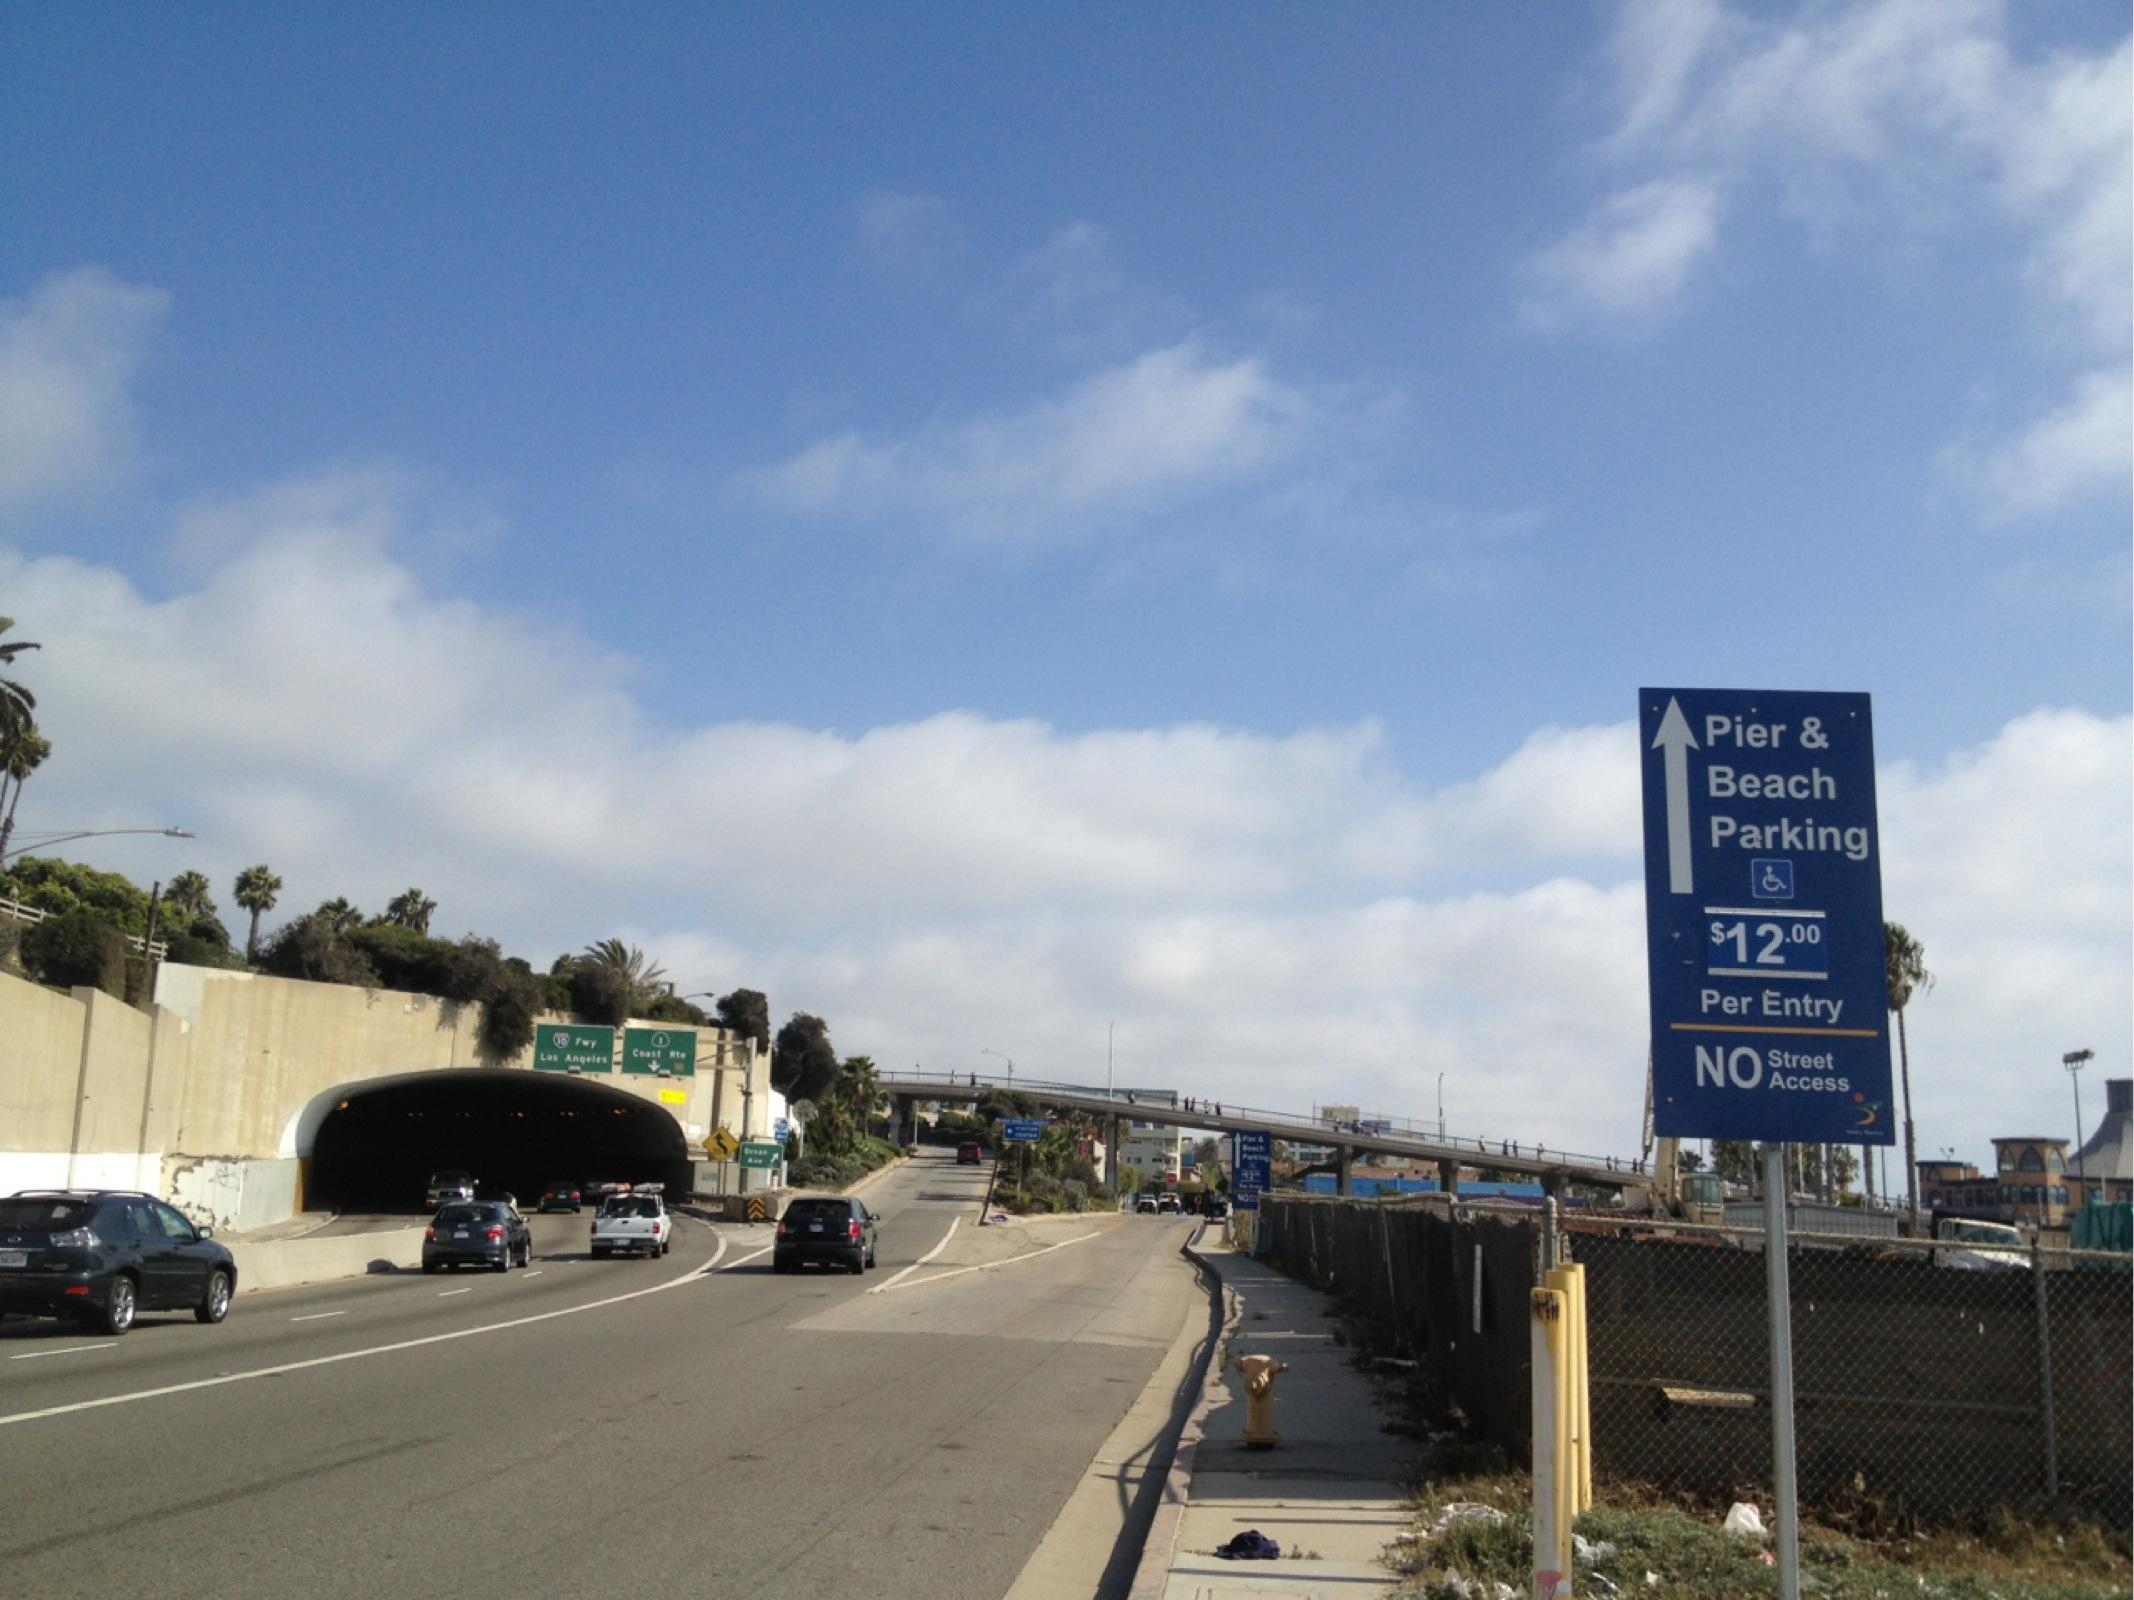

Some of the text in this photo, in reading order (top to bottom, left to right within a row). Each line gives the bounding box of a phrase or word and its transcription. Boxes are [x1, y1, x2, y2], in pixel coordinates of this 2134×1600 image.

[1705, 714, 1830, 749] Pier &
[1707, 765, 1836, 800] Beach
[1710, 816, 1869, 860] Parking
[1710, 921, 1821, 964] $12.00
[1700, 989, 1843, 1024] Per Entry
[541, 1052, 608, 1066] Los Angeles
[575, 1037, 598, 1049] Fwy
[1767, 1050, 1835, 1071] Street
[1694, 1044, 1763, 1089] NO
[1768, 1072, 1850, 1092] Access
